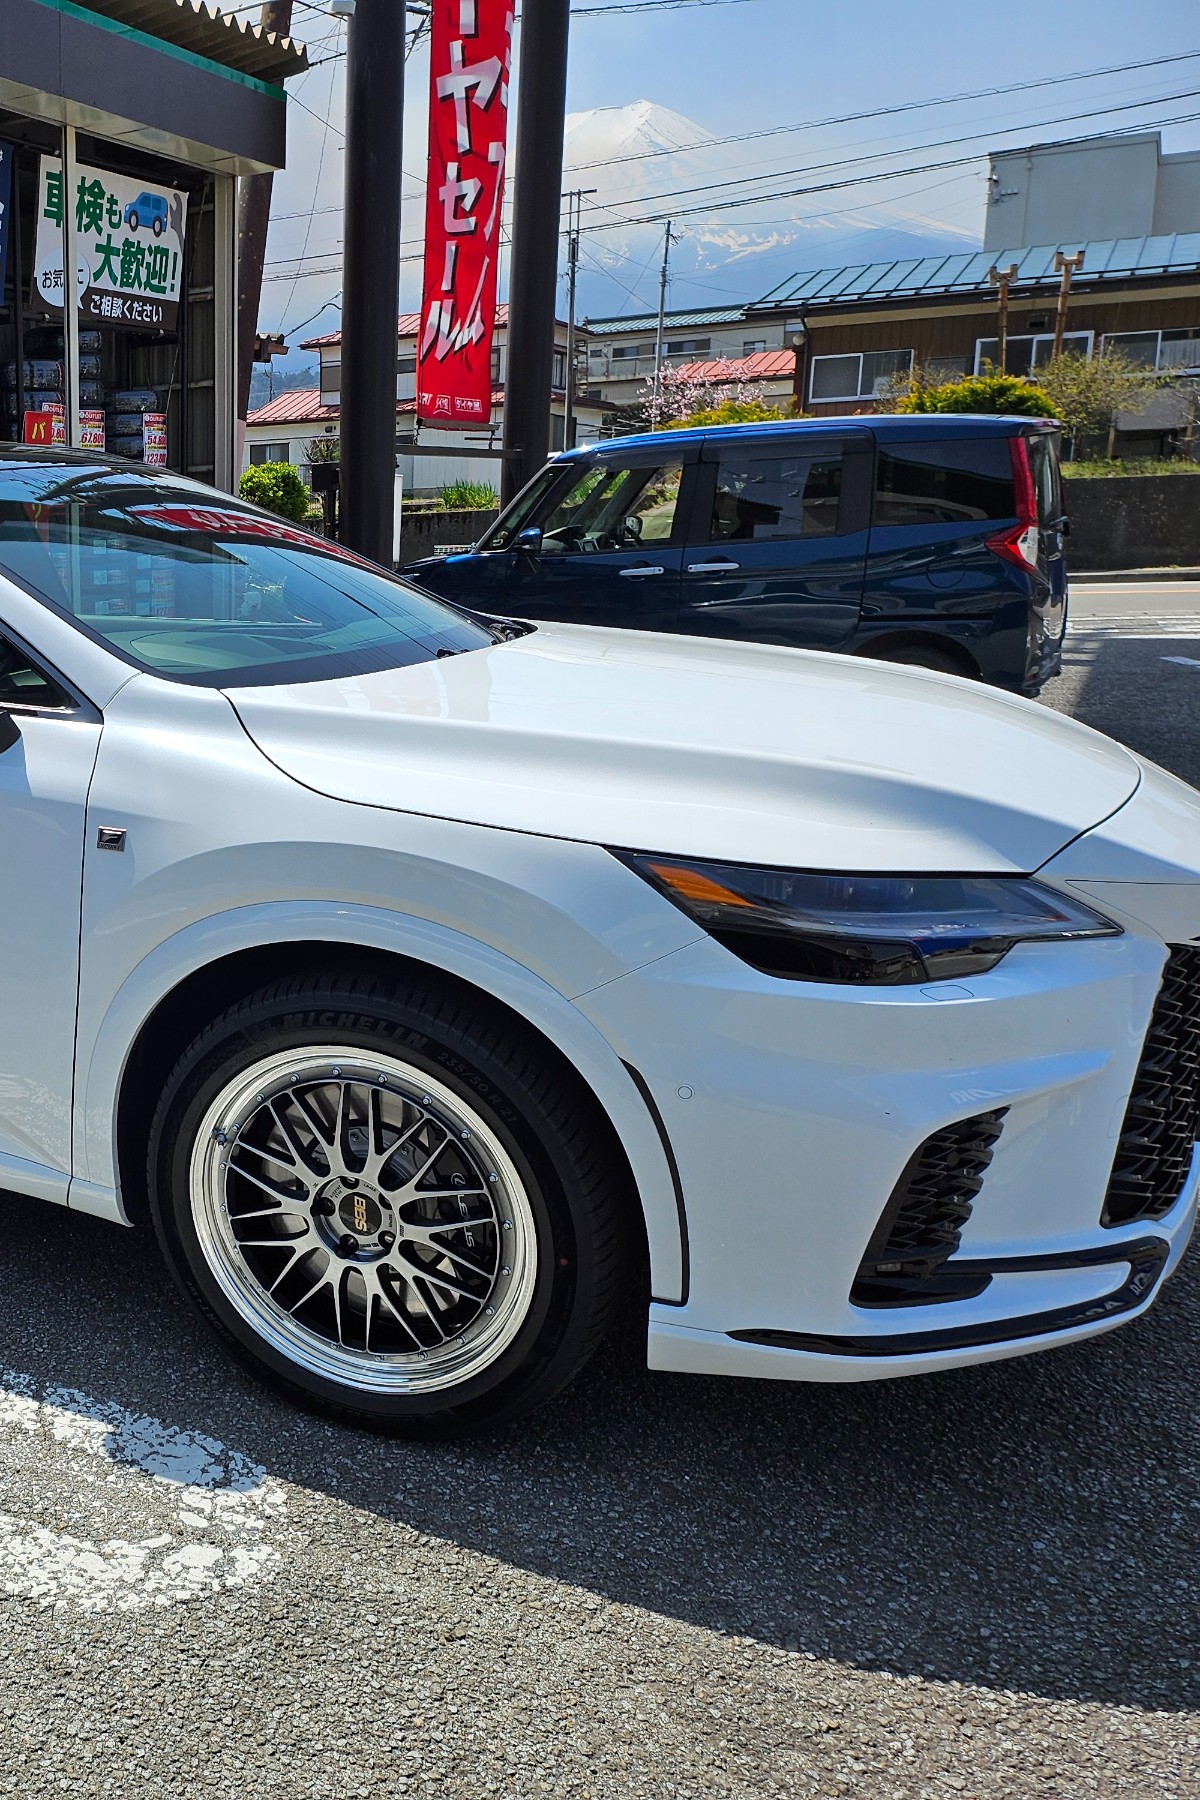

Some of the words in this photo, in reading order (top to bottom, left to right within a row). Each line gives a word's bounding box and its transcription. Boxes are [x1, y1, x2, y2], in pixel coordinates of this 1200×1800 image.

[43, 170, 123, 236] 車検も
[41, 267, 84, 289] お気に
[92, 233, 179, 295] 大歓迎!
[89, 294, 163, 323] ご相談ください
[283, 1011, 429, 1048] MICHELIN
[353, 1195, 368, 1232] BBS
